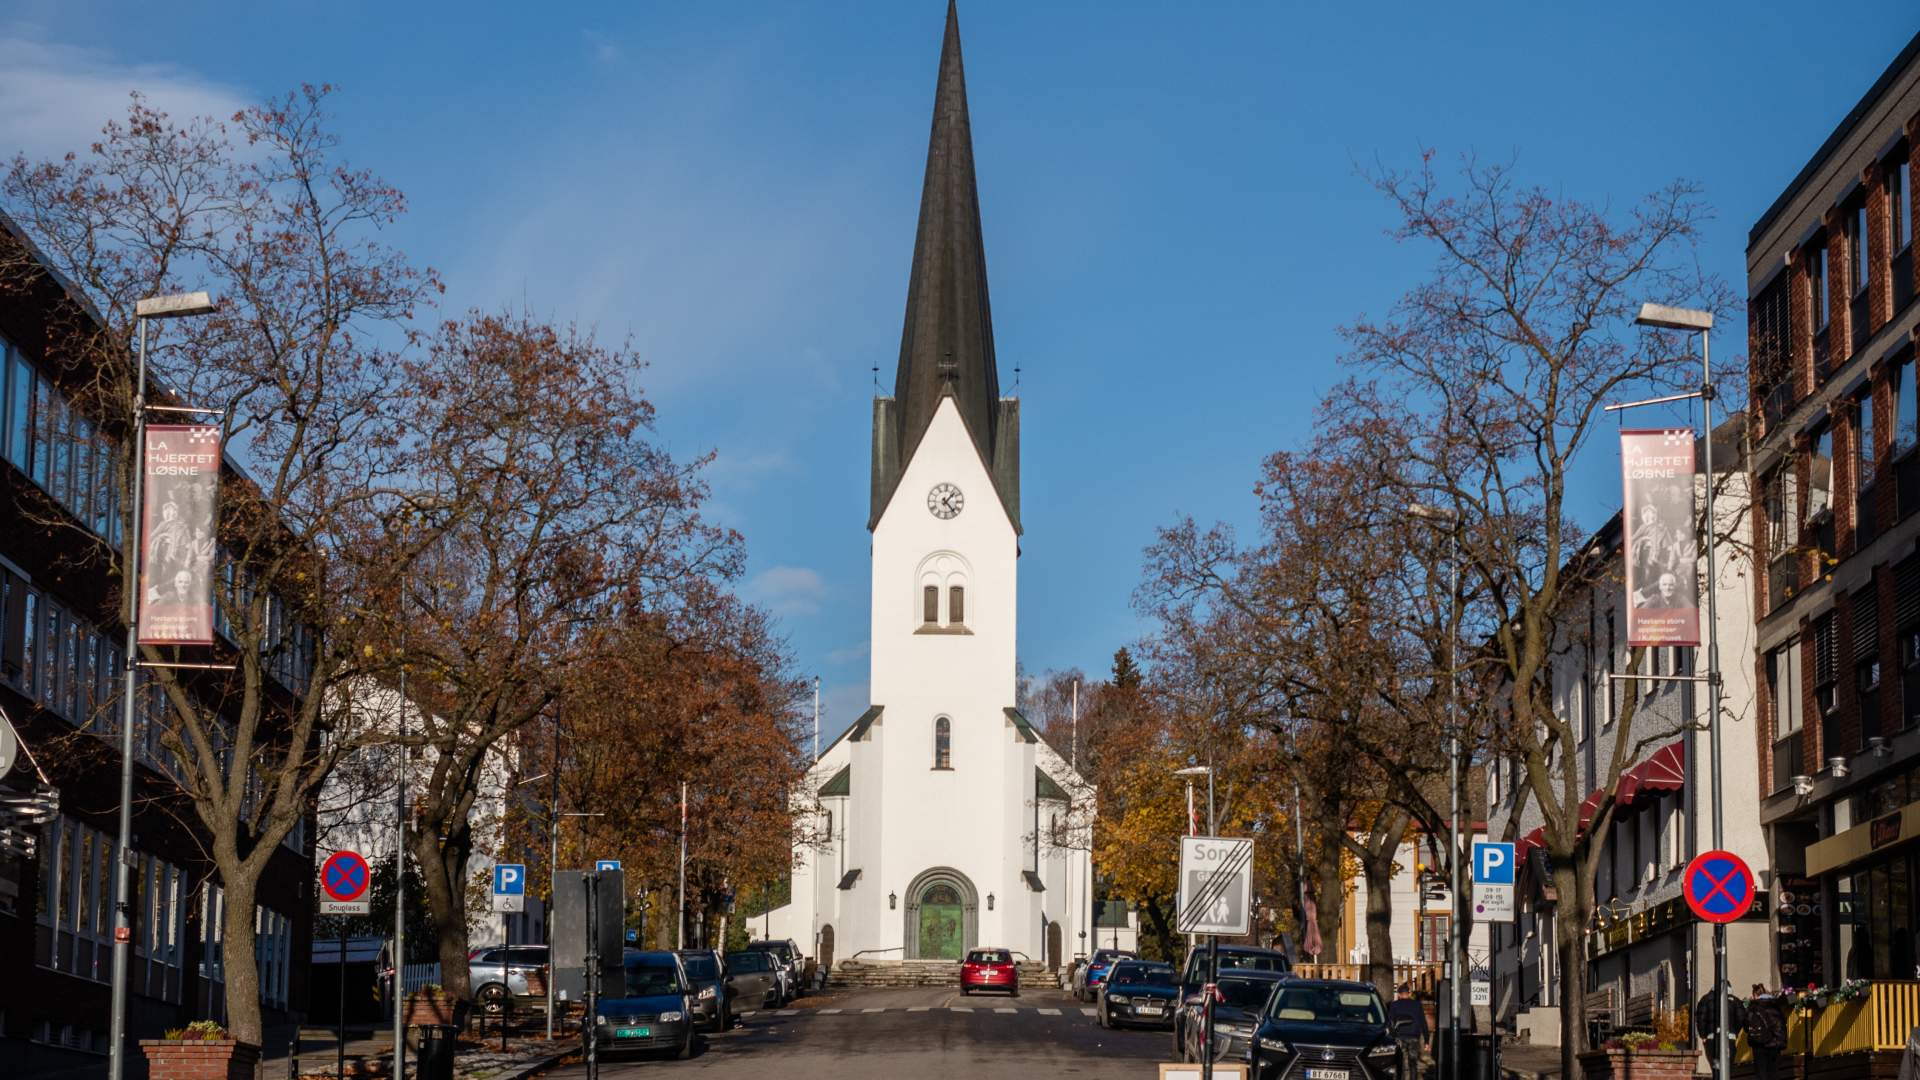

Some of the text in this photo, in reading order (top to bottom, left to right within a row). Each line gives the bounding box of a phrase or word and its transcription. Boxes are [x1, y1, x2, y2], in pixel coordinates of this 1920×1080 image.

[149, 441, 168, 450] LA
[148, 454, 215, 464] HJERTET
[1624, 456, 1691, 466] HJERTET
[148, 466, 199, 476] LØSNE
[1483, 848, 1504, 879] P
[501, 868, 518, 892] P
